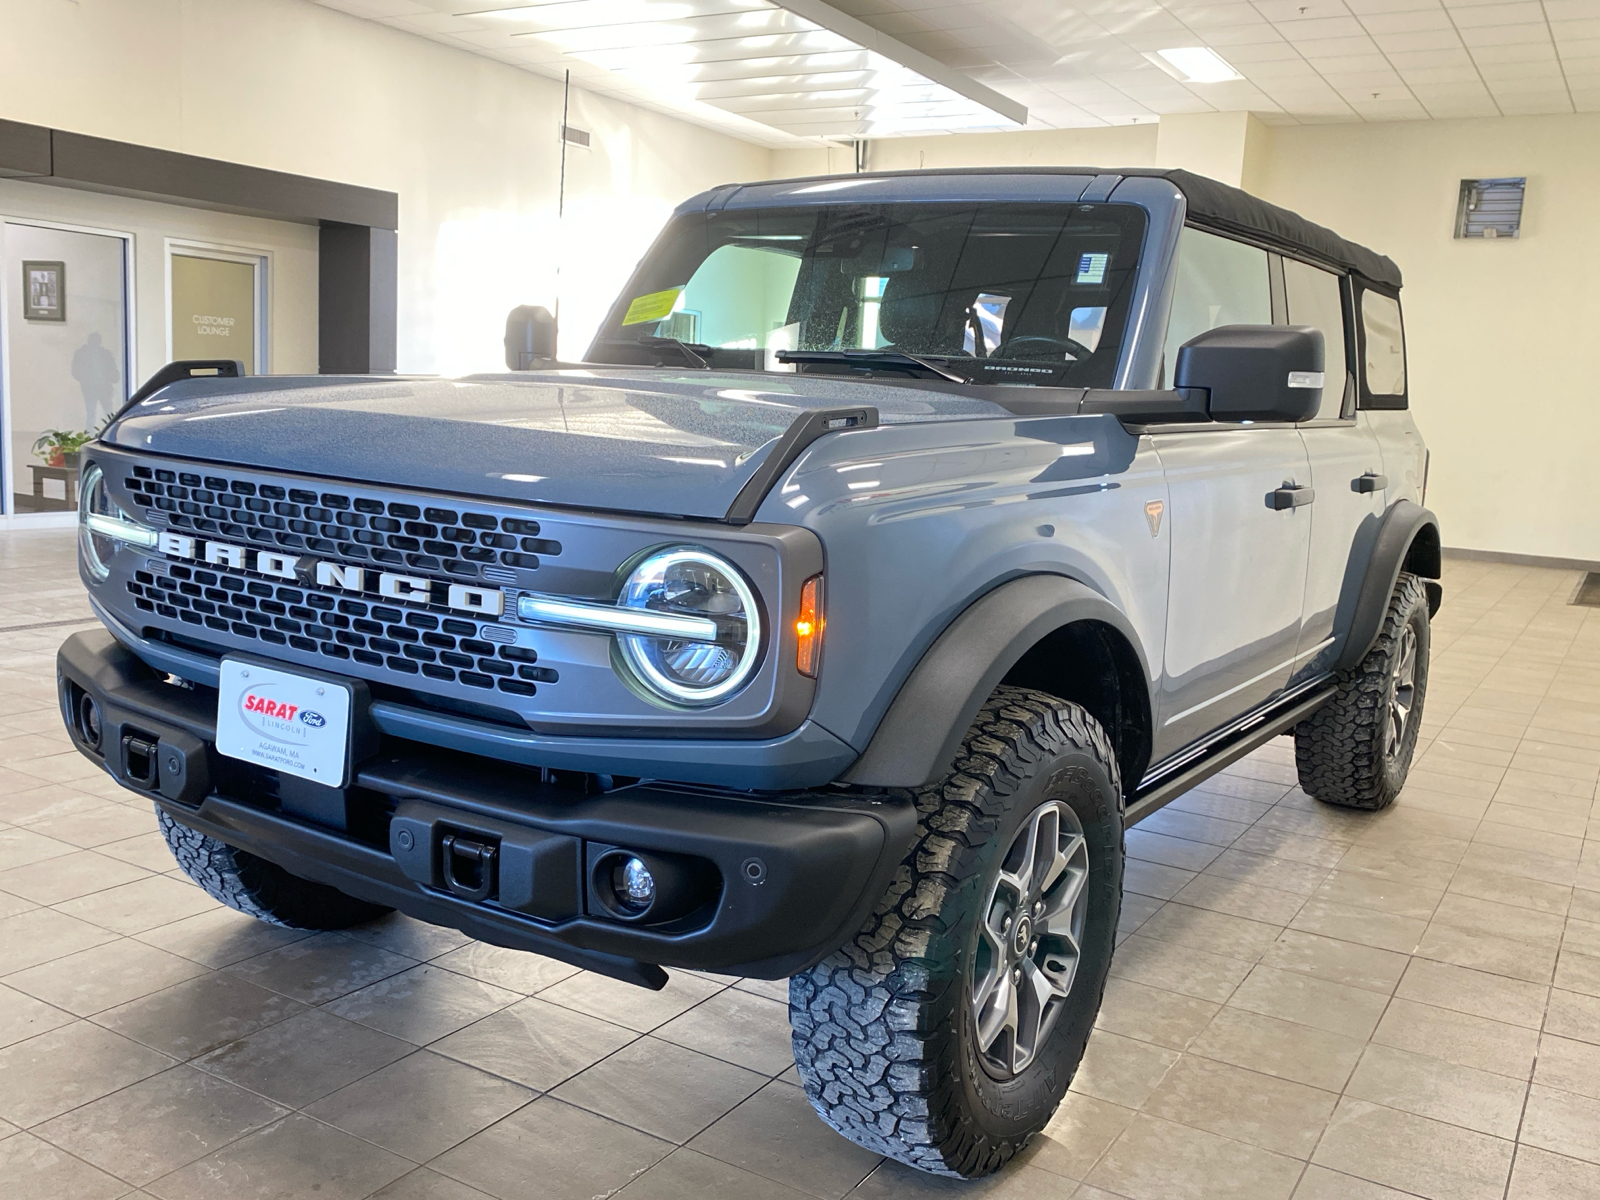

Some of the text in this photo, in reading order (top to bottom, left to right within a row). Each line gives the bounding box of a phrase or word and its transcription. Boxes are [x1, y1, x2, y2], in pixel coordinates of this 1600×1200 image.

[192, 314, 235, 326] CUSTOMER
[197, 325, 230, 336] LOUNGE
[158, 531, 503, 616] BRONCO
[244, 693, 323, 728] SARAT Ford
[267, 720, 302, 735] LINCOLN
[258, 741, 300, 759] AGAWAM, MA
